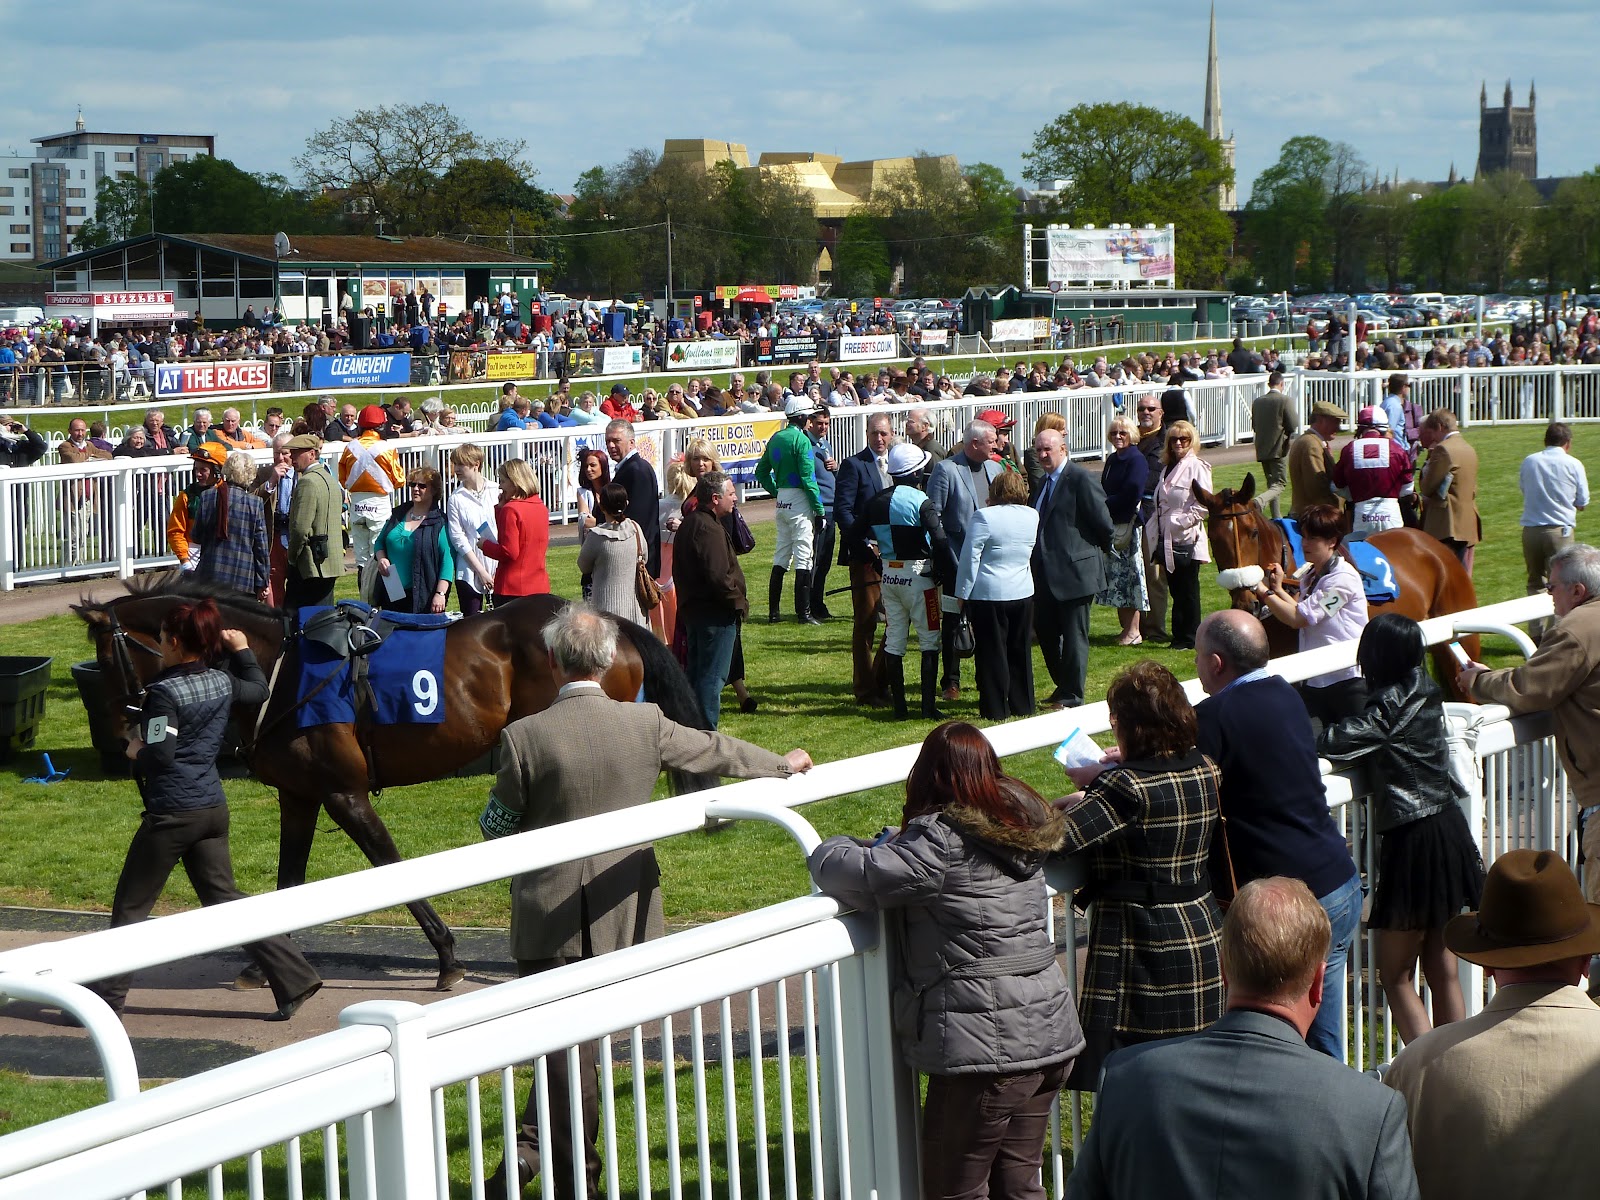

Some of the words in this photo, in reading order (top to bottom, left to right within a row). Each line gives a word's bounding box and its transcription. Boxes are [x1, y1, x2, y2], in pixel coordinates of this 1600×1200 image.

[726, 288, 738, 296] tote
[767, 287, 778, 295] tote
[780, 286, 797, 298] betting
[103, 293, 166, 304] SIZZLER
[724, 346, 735, 356] SHOP
[844, 340, 893, 354] FREEBETS.CO.UK
[331, 356, 394, 376] CLEANEVENT
[500, 362, 508, 370] love
[516, 361, 527, 371] Dogs!
[160, 370, 181, 391] AT
[185, 368, 215, 389] THE
[217, 366, 267, 388] RACES
[708, 427, 724, 441] SELL
[1361, 513, 1391, 522] Stobart
[882, 574, 913, 586] Stobart
[1375, 556, 1396, 591] 2
[1325, 596, 1339, 610] 2
[412, 669, 439, 716] 9
[154, 723, 161, 736] 9
[486, 818, 514, 836] OFFIC
